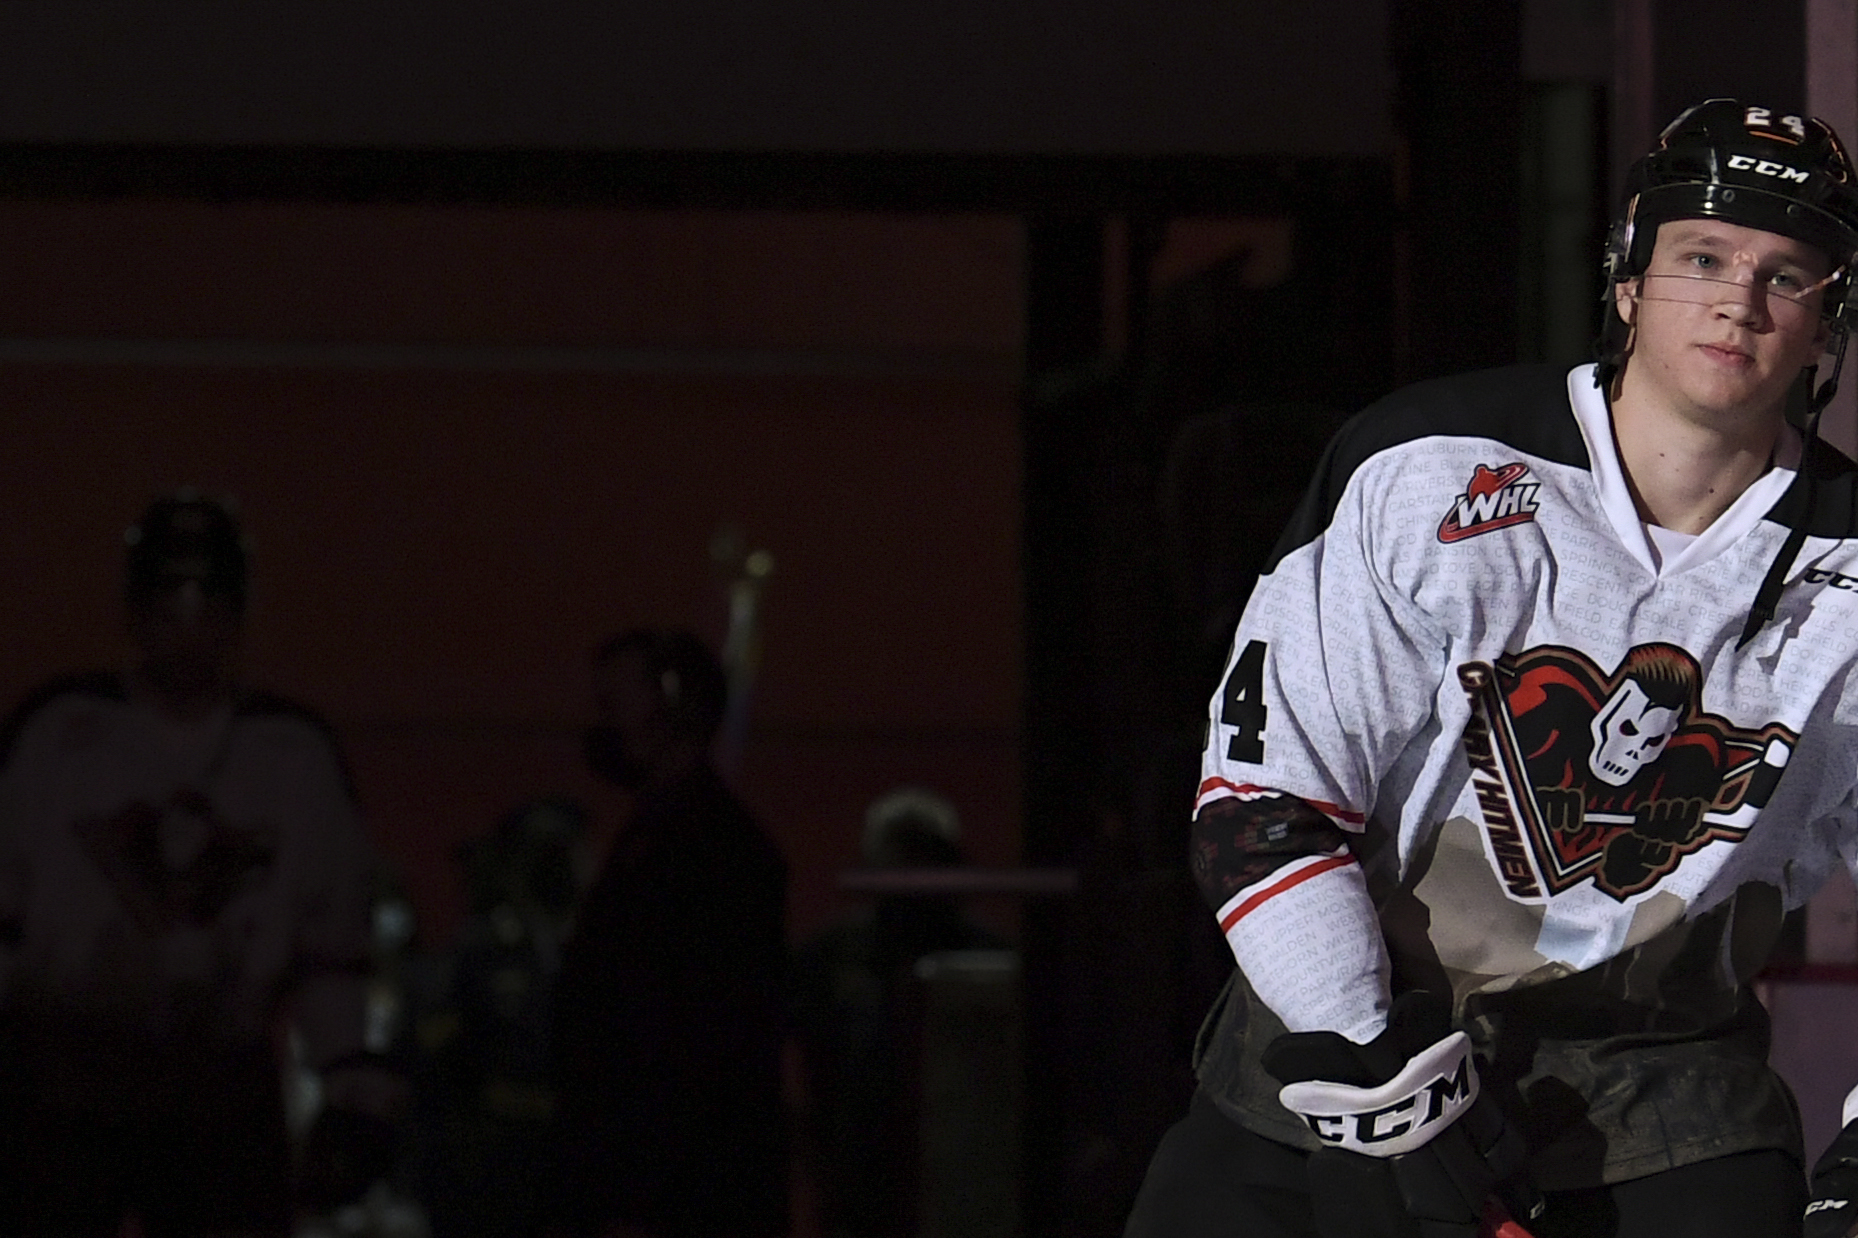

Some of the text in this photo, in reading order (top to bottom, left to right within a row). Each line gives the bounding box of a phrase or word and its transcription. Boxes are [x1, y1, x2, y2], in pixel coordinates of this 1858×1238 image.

[1746, 107, 1805, 139] 24
[1728, 154, 1810, 183] CCM
[1454, 481, 1543, 529] WHL
[1221, 640, 1267, 765] 4
[1305, 1054, 1470, 1144] CCM
